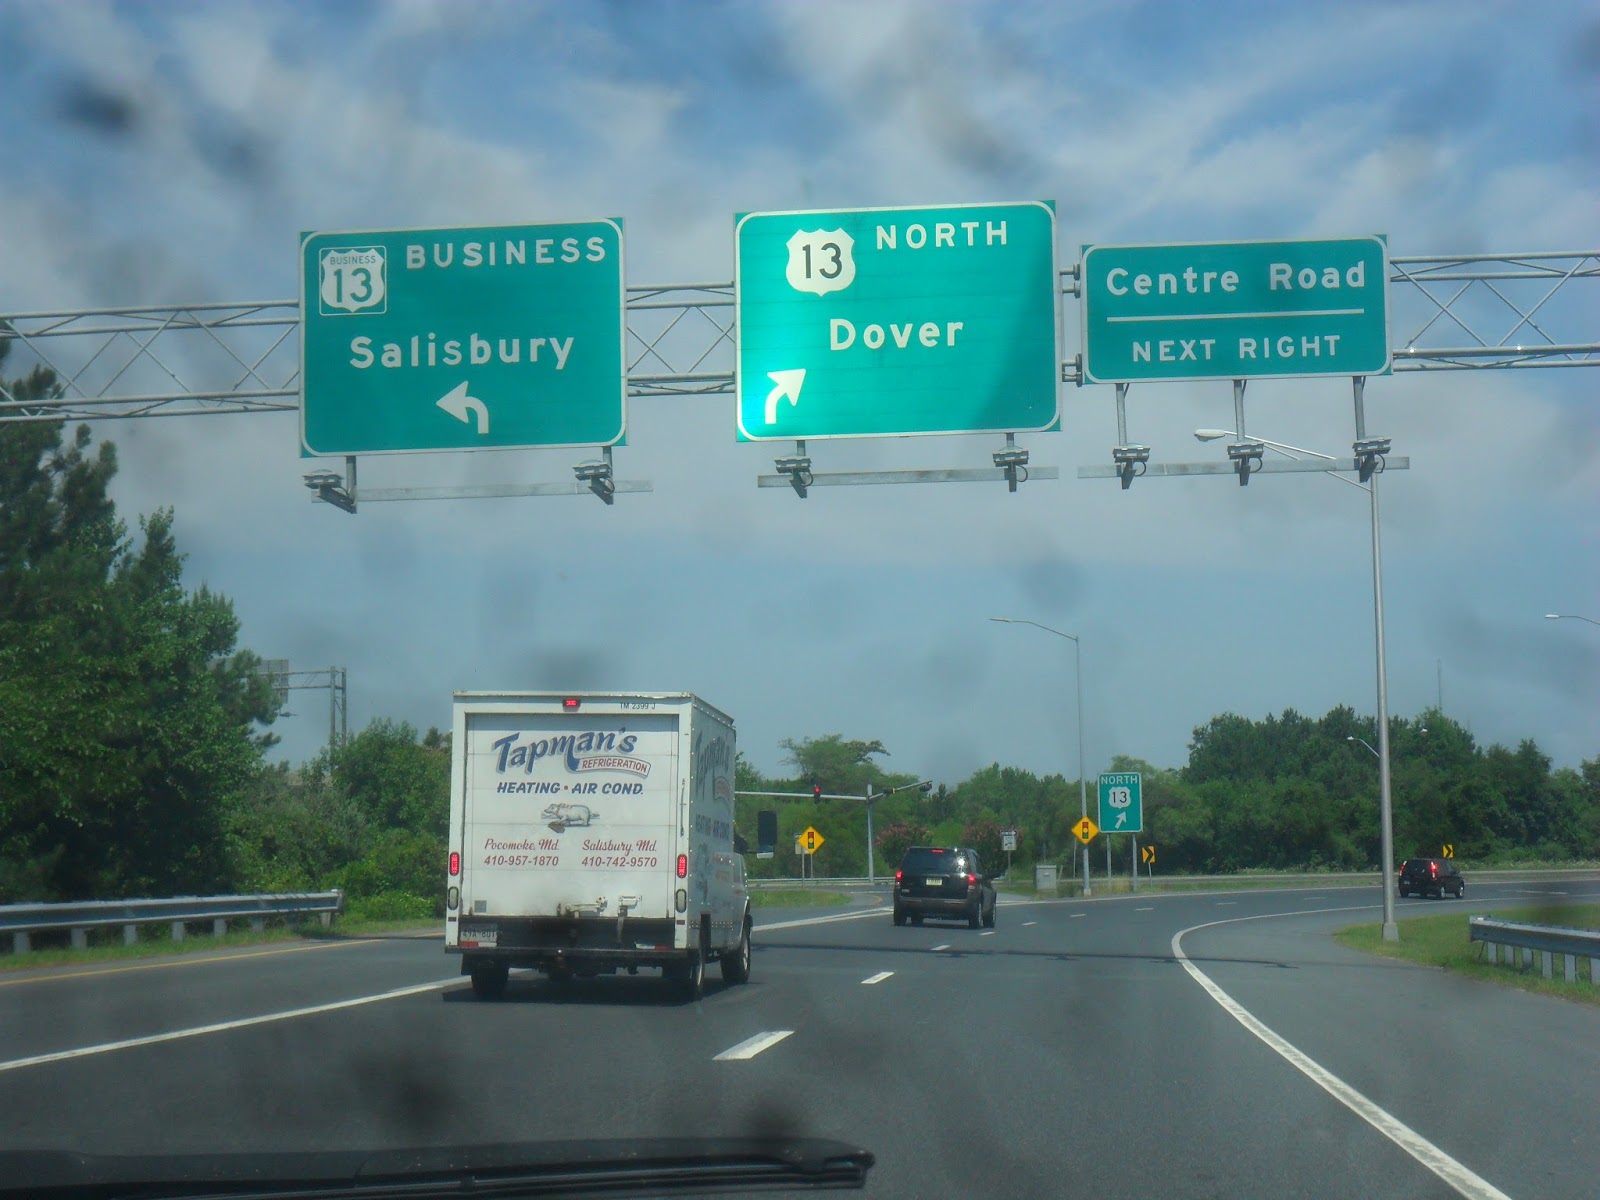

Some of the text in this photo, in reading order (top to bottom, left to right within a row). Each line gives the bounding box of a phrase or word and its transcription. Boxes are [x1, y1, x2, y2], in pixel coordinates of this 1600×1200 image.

[877, 220, 1008, 249] NORTH
[329, 255, 377, 266] BUSINESS
[406, 237, 606, 269] BUSINESS
[801, 242, 843, 279] 13
[333, 267, 373, 303] 13
[1106, 260, 1365, 296] Centre Road
[830, 318, 964, 351] Dover
[350, 333, 574, 371] Salisbury
[1132, 335, 1341, 362] NEXT RIGHT
[620, 702, 630, 710] TM
[631, 702, 649, 710] 2399
[492, 726, 638, 774] Tapman's
[581, 757, 648, 773] REFRIGERATION
[497, 782, 644, 795] HEATING AIR COND.
[1100, 775, 1138, 785] NORTH
[1112, 791, 1128, 804] 13
[484, 855, 559, 867] 410-957-1870
[581, 856, 658, 868] 410-742-9570
